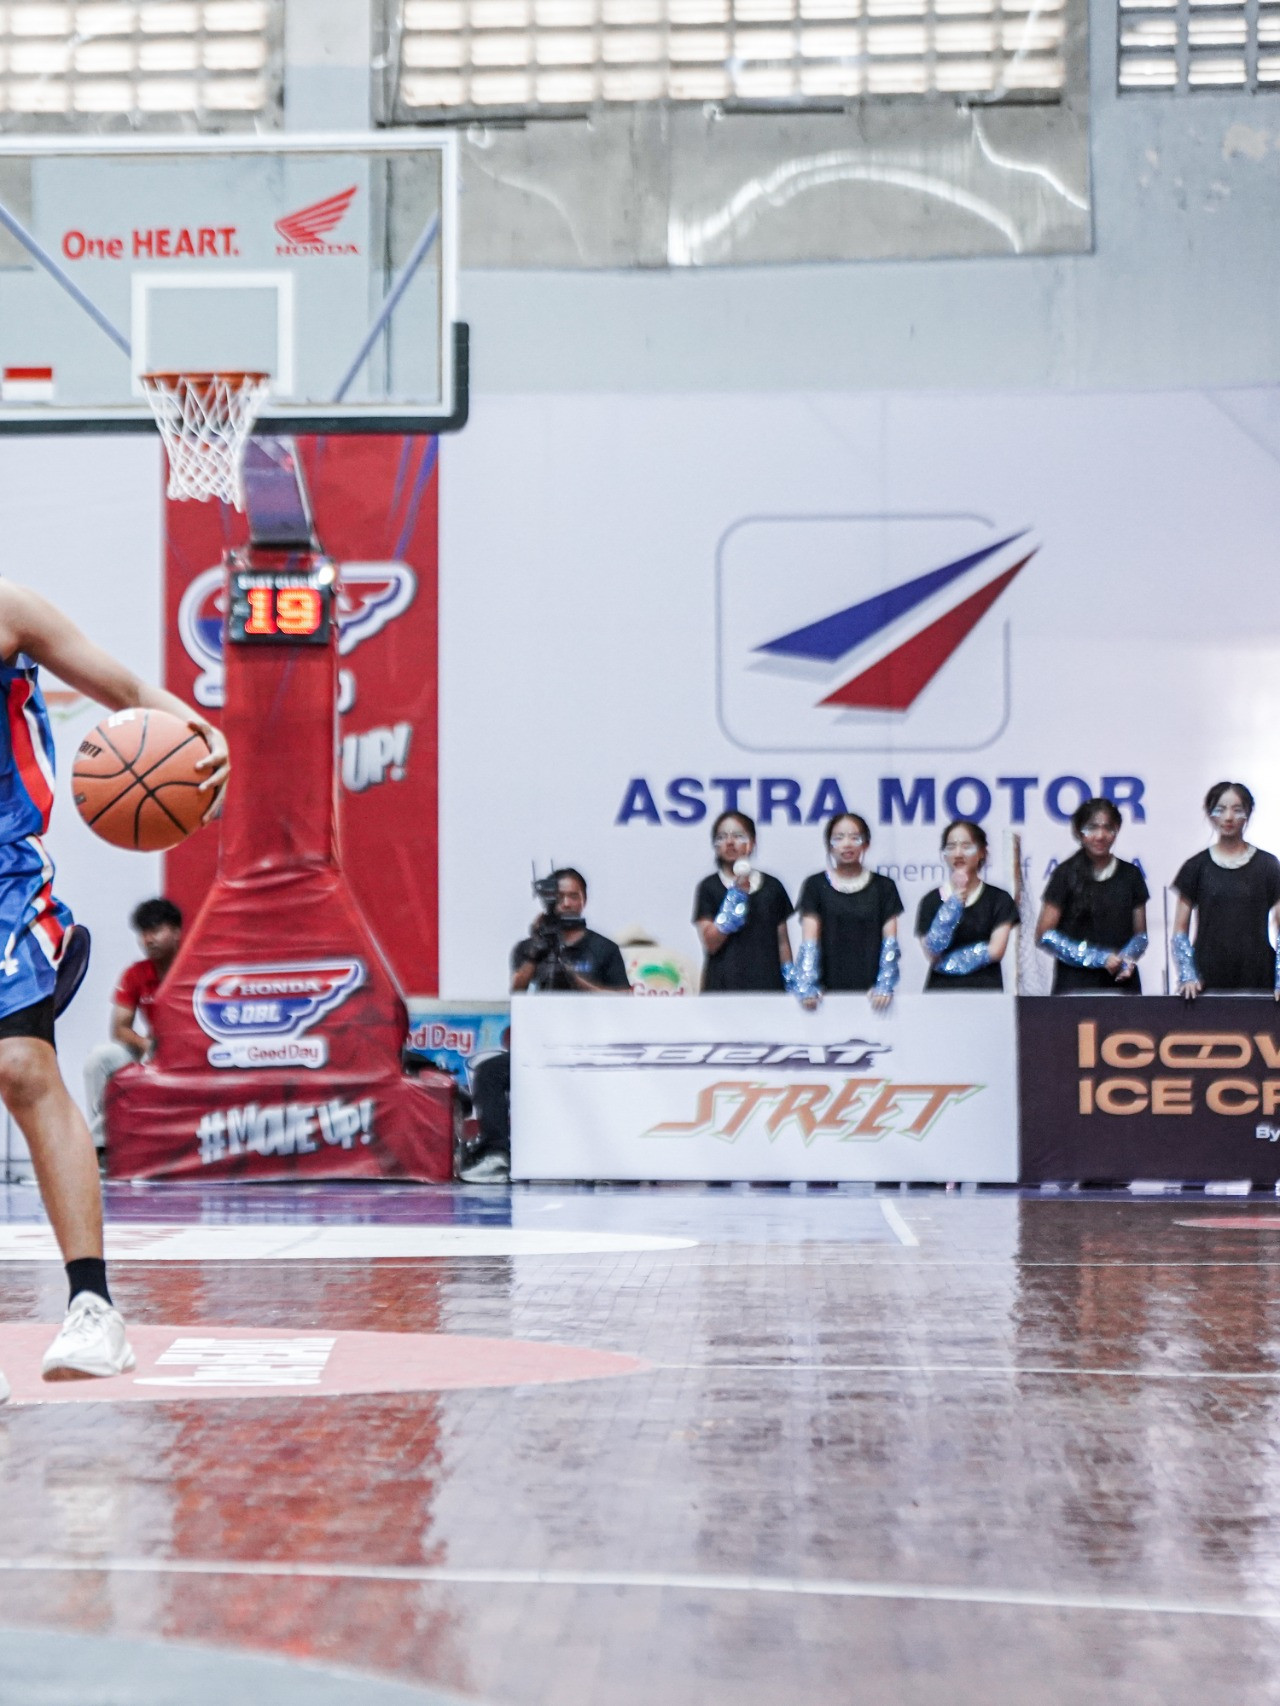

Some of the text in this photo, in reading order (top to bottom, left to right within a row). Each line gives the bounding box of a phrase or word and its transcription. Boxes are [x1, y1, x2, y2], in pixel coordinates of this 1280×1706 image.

[62, 227, 239, 261] One HEART.
[275, 244, 361, 257] HONDA
[245, 587, 322, 635] 19
[341, 724, 413, 791] UP!
[614, 775, 1148, 828] ASTRA MOTOR
[239, 979, 322, 997] HONDA
[239, 1004, 281, 1024] DBL
[247, 1046, 287, 1061] Good
[289, 1044, 320, 1062] Day
[432, 1025, 472, 1054] Day
[638, 1077, 986, 1146] STREET
[1078, 1078, 1194, 1116] ICE
[196, 1103, 319, 1165] #MOVE
